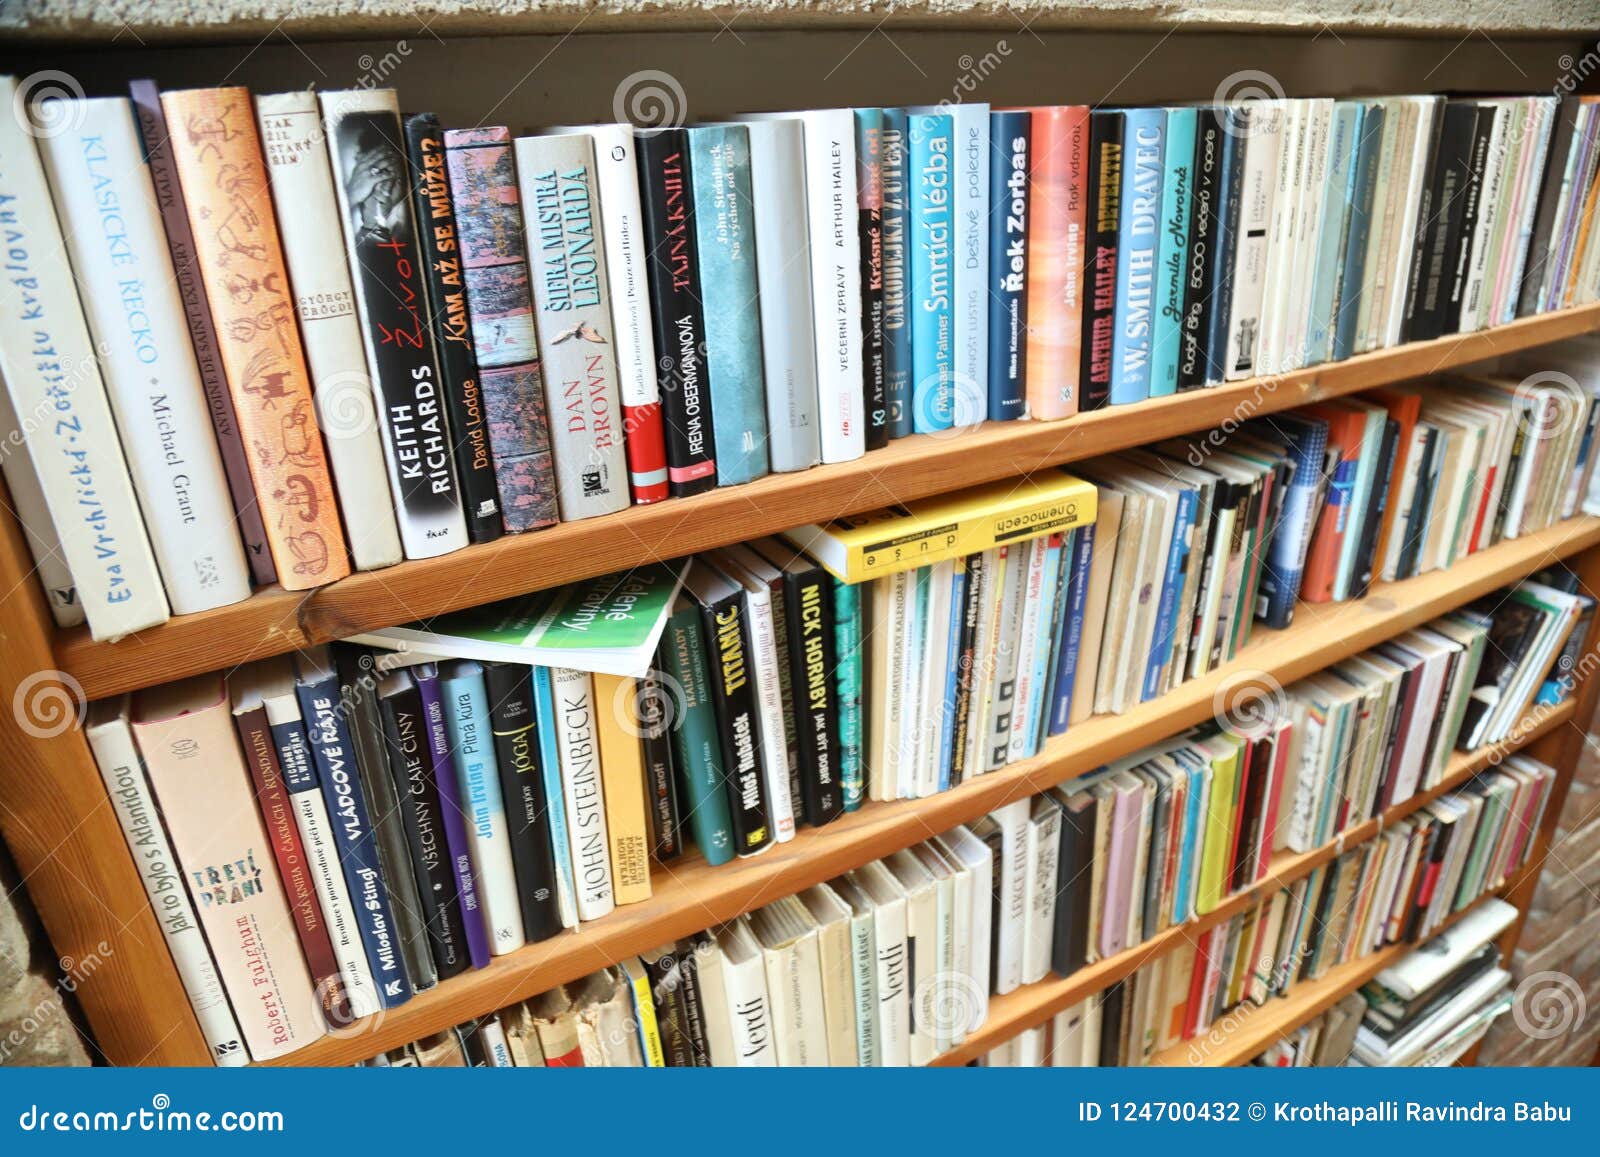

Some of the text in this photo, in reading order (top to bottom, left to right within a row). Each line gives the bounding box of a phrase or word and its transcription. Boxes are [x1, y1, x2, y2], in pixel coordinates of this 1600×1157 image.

[265, 117, 294, 129] TAK
[710, 144, 729, 245] John Steinbeck
[832, 140, 845, 248] ARTHUR HAILEY
[966, 127, 982, 269] Deštivé poledne
[1068, 125, 1082, 210] Rok vdovou
[1131, 127, 1161, 237] DRAVEC
[80, 136, 158, 364] KLASICKÉ ŘECKO
[420, 138, 472, 349] KAM AŽ SE MŮŽE?
[536, 170, 572, 312] ŠIFRA MISTRA
[562, 166, 600, 309] LEONARDA
[664, 152, 689, 293] TAJNÁ KNIHA
[732, 246, 744, 261] Na
[922, 136, 948, 312] Smrtící léčba
[1000, 137, 1026, 292] Řek Zorbas
[1162, 167, 1188, 324] Jarmila Novotná
[376, 239, 423, 349] Život
[869, 227, 882, 290] Krásné
[1064, 223, 1079, 308] John Irving
[1125, 248, 1153, 340] SMITH
[1191, 241, 1205, 288] 5000
[835, 319, 848, 372] VEČERNÍ
[872, 300, 882, 346] Lustig
[1091, 246, 1116, 383] ARTHUR HAILEY
[202, 359, 232, 436] ANTOINE DE
[585, 355, 612, 449] BROWN
[674, 315, 702, 417] OBERMANNOVÁ
[936, 314, 949, 413] Michael Palmer
[1009, 354, 1017, 379] Nikos
[391, 405, 423, 478] KEITH
[411, 365, 450, 493] RICHARDS
[463, 379, 488, 470] David Lodge
[562, 380, 586, 433] DAN
[689, 419, 704, 455] IRENA
[150, 394, 195, 524] Michael Grant
[101, 564, 132, 604] Eva
[605, 575, 656, 622] Zelené
[674, 628, 698, 709] SKALNÍ HRADY
[715, 604, 748, 698] TITANIC
[802, 583, 828, 711] NICK HORNBY
[251, 729, 277, 790] KUNDALINI
[458, 693, 478, 755] Pitná kúra
[511, 732, 536, 773] JÓGA
[564, 693, 601, 828] STEINBECK
[733, 712, 761, 812] Miloš Hubáček
[813, 712, 833, 785] JAK BÝT DOBRÝ
[114, 765, 154, 846] Atlantidou
[270, 791, 281, 801] A
[313, 697, 362, 842] VLÁDCOVÉ RÁJE
[397, 711, 439, 871] VŠECHNY ČAJE ČÍNY
[466, 762, 492, 838] John Irving
[272, 803, 294, 854] ČAKRÁCH
[287, 854, 297, 865] O
[581, 831, 610, 892] JOHN
[150, 861, 177, 894] bylo
[163, 893, 182, 910] to
[290, 865, 311, 904] KNIHA
[356, 867, 397, 971] Miloslav Stingl
[166, 911, 195, 935] Jak
[334, 911, 350, 947] Revoluce
[236, 915, 289, 1045] Robert Fulghum
